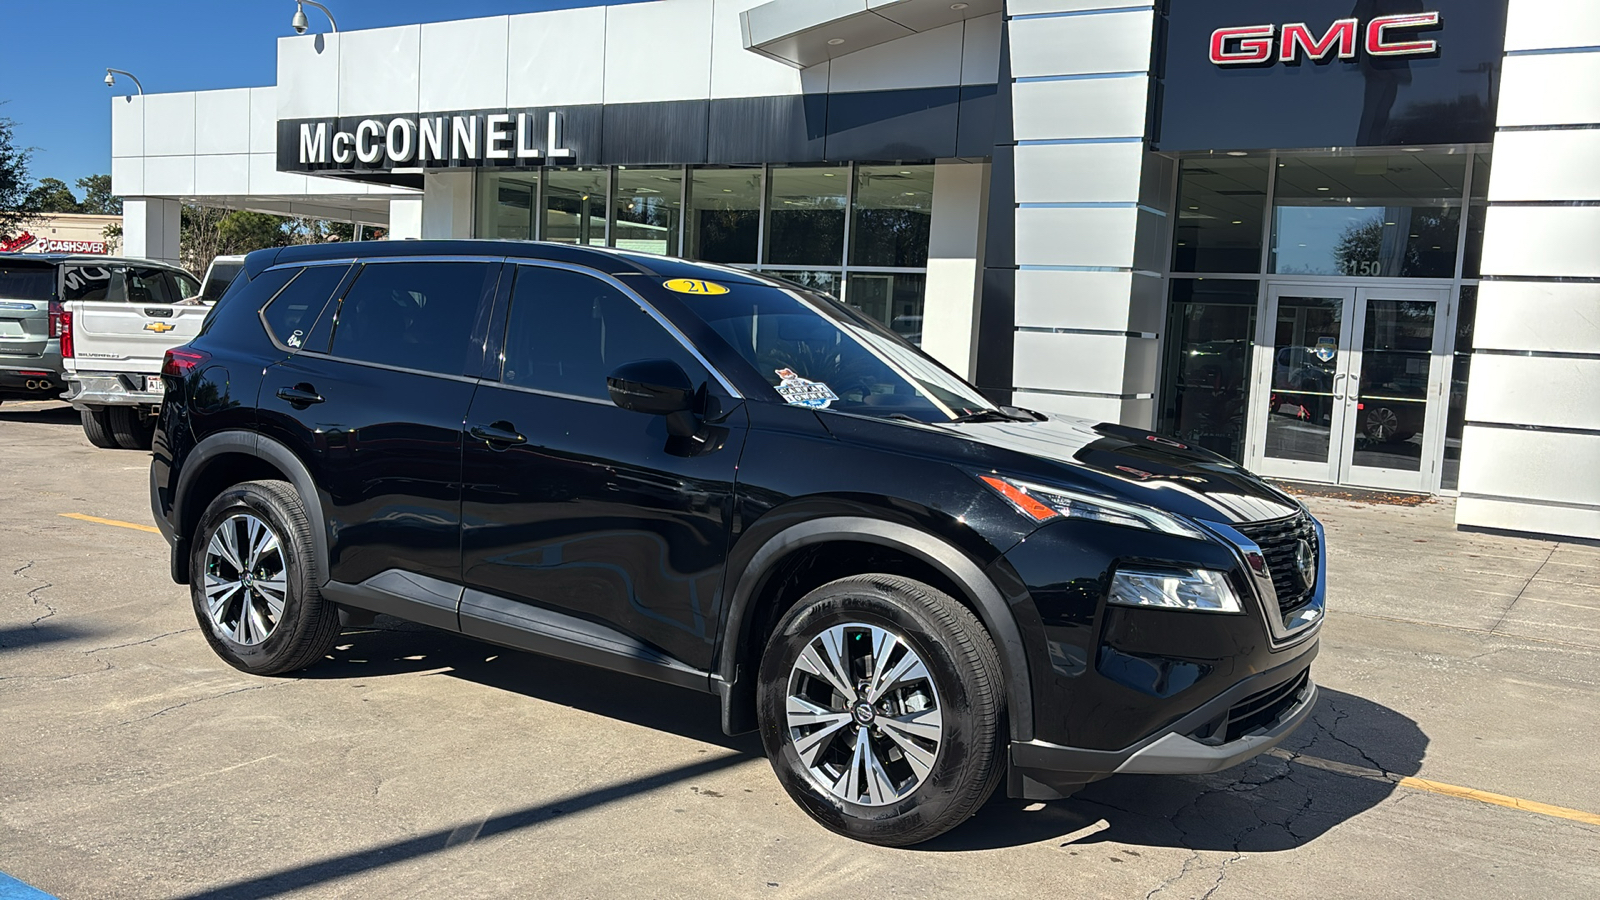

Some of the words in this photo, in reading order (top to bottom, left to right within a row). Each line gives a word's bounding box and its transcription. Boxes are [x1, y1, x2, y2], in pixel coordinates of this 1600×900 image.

[1209, 12, 1440, 64] GMC
[299, 111, 571, 164] McCONNELL
[49, 240, 104, 252] CASHSAVER
[683, 280, 709, 293] 21
